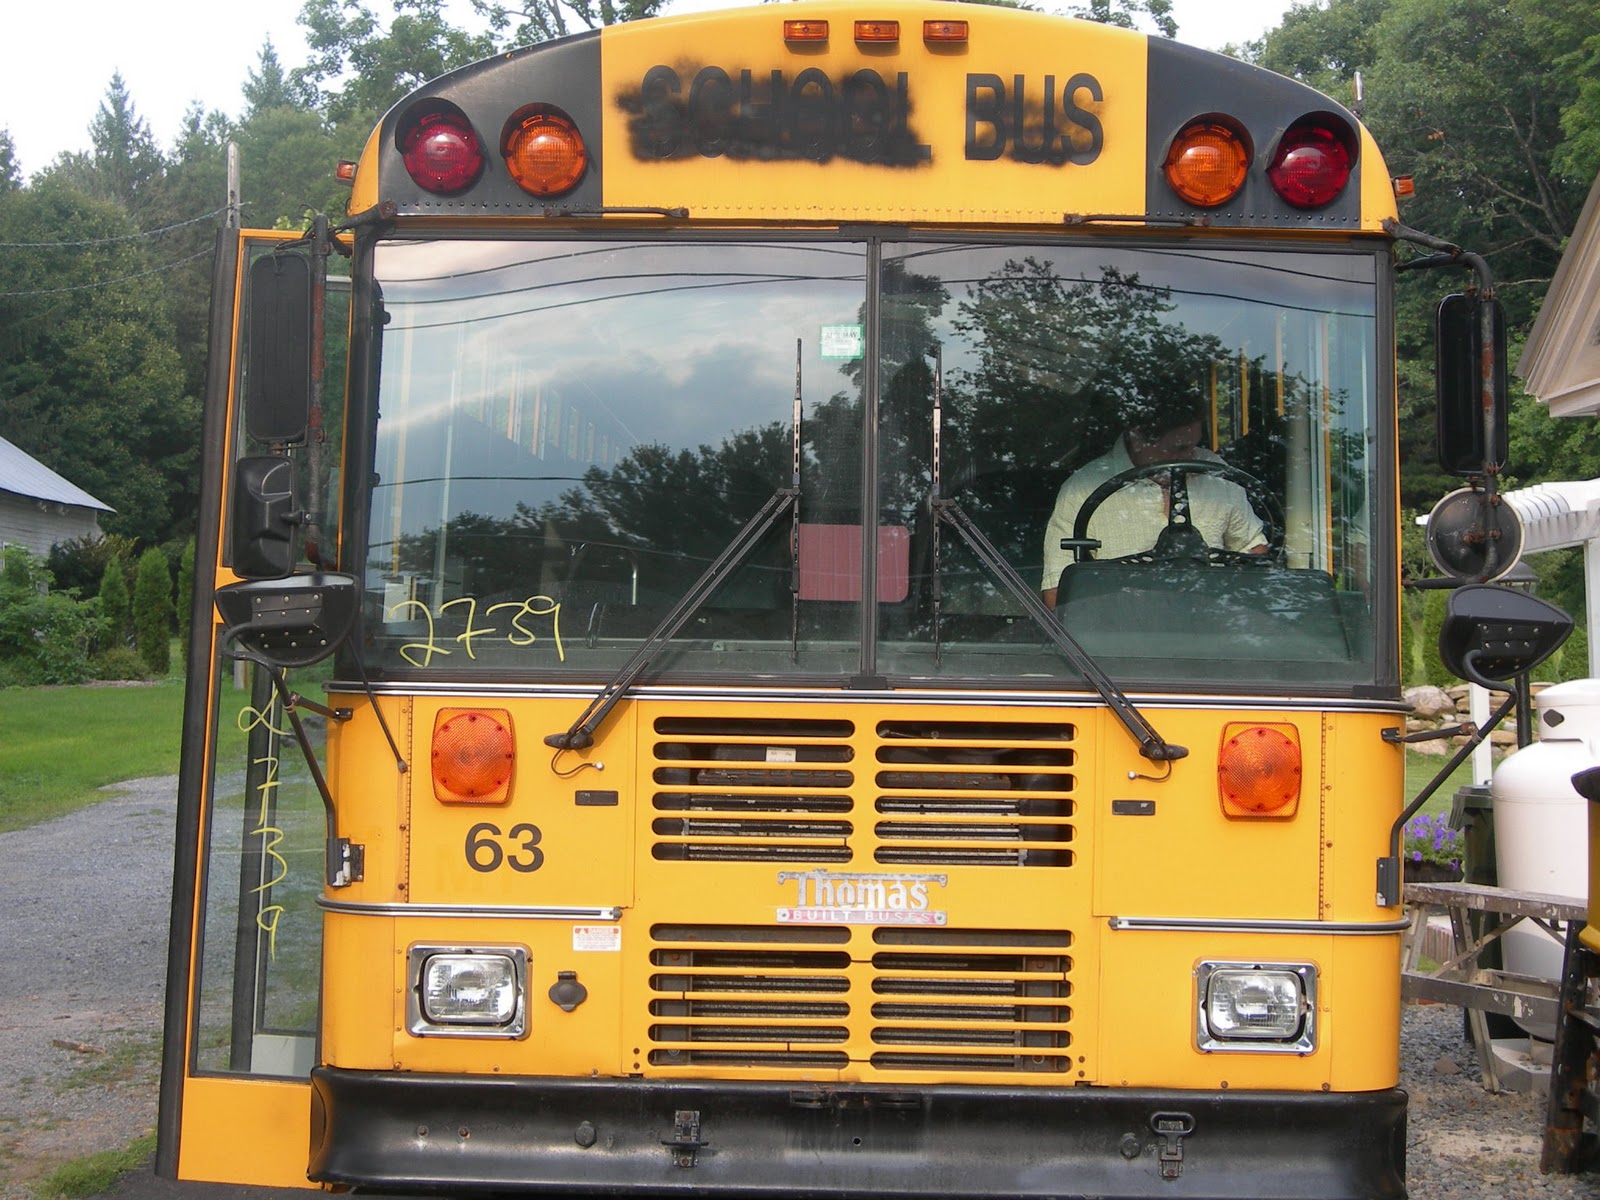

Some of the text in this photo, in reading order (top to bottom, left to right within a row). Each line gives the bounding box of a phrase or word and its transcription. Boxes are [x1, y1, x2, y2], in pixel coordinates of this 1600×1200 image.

[964, 72, 1104, 165] BUS
[387, 595, 565, 668] 2739
[465, 822, 544, 873] 63
[793, 868, 930, 911] Thomas
[792, 910, 931, 922] BUILT BUSES
